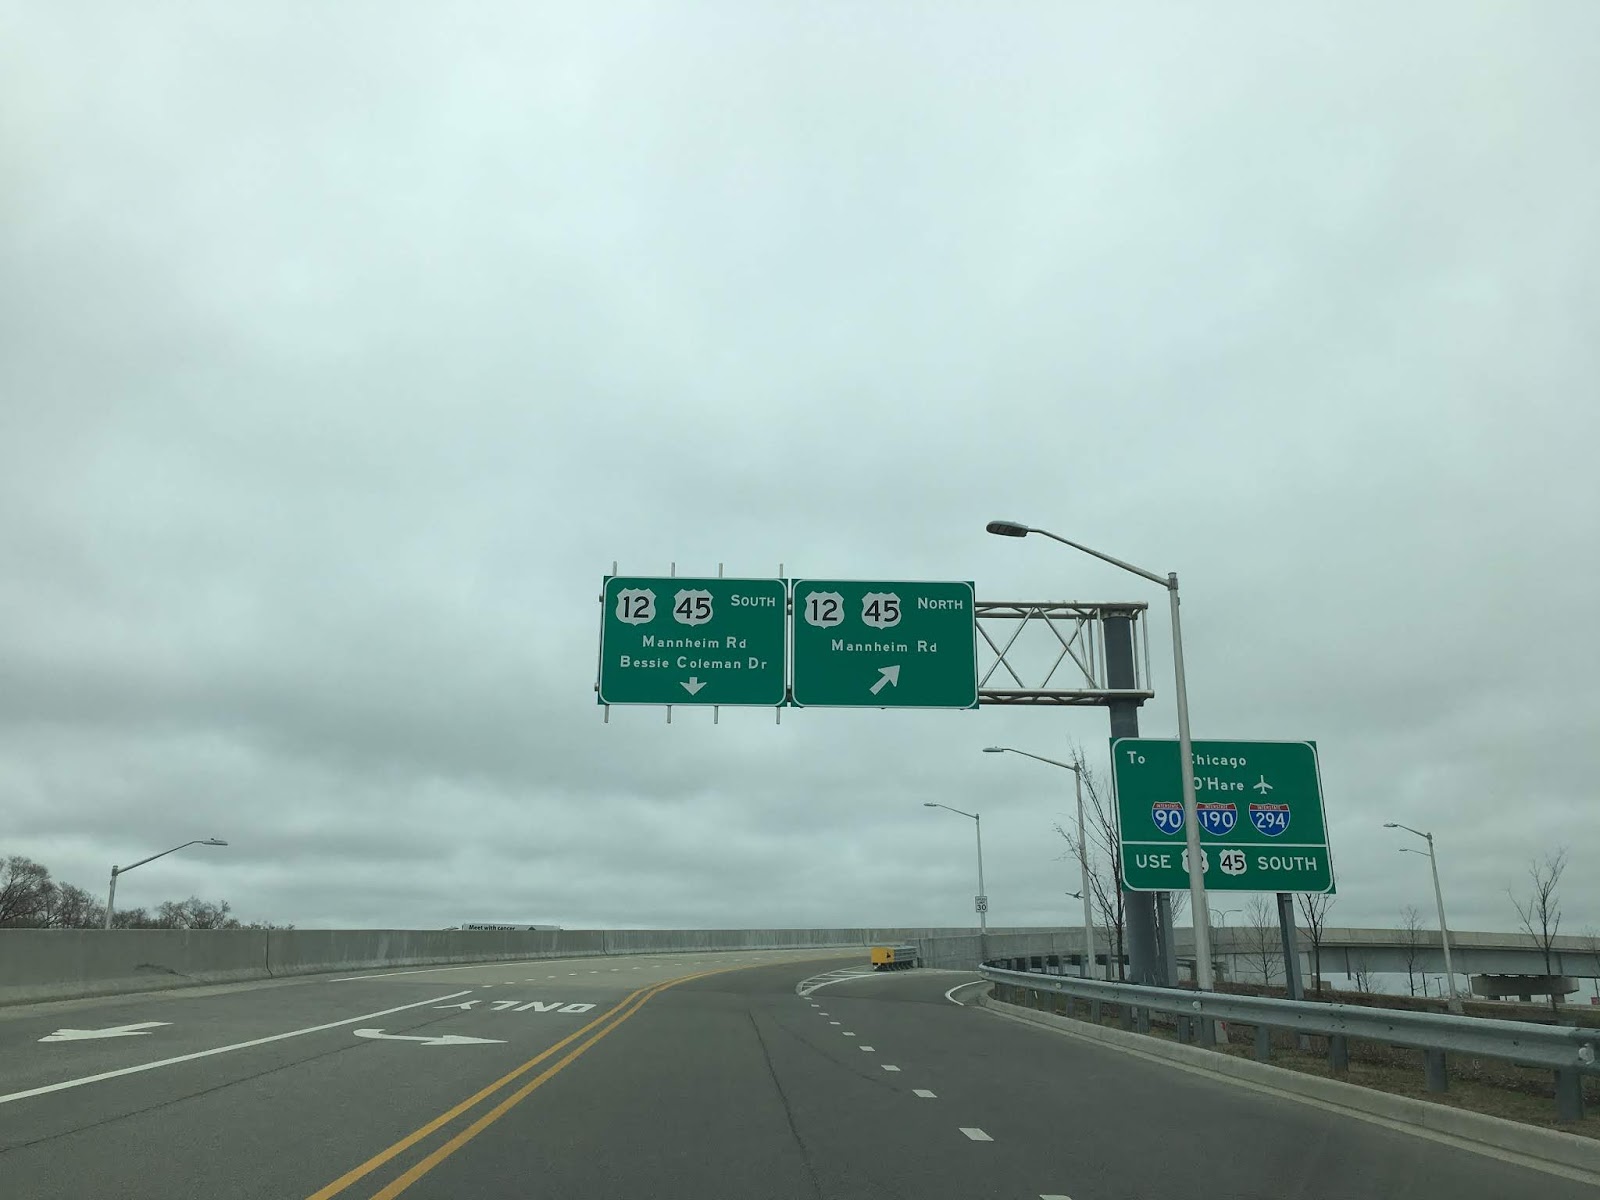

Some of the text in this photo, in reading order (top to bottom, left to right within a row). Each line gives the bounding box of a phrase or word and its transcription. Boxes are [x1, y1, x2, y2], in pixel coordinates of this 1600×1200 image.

[623, 596, 650, 618] 12
[676, 597, 711, 620] 45
[730, 594, 776, 607] SOUTH
[918, 597, 963, 610] NORTH
[811, 599, 838, 621] 12
[864, 600, 899, 622] 45
[642, 636, 746, 648] Mannheim Rd
[832, 640, 937, 652] Mannheim Rd
[620, 656, 767, 670] Bessie Coleman Dr
[1127, 751, 1146, 764] To
[1192, 752, 1246, 768] hicago
[1155, 810, 1182, 828] 90
[1202, 811, 1234, 828] 190
[1256, 812, 1286, 828] 294
[1136, 854, 1172, 869] USE
[1222, 854, 1245, 870] 45
[1258, 856, 1318, 870] SOUTH
